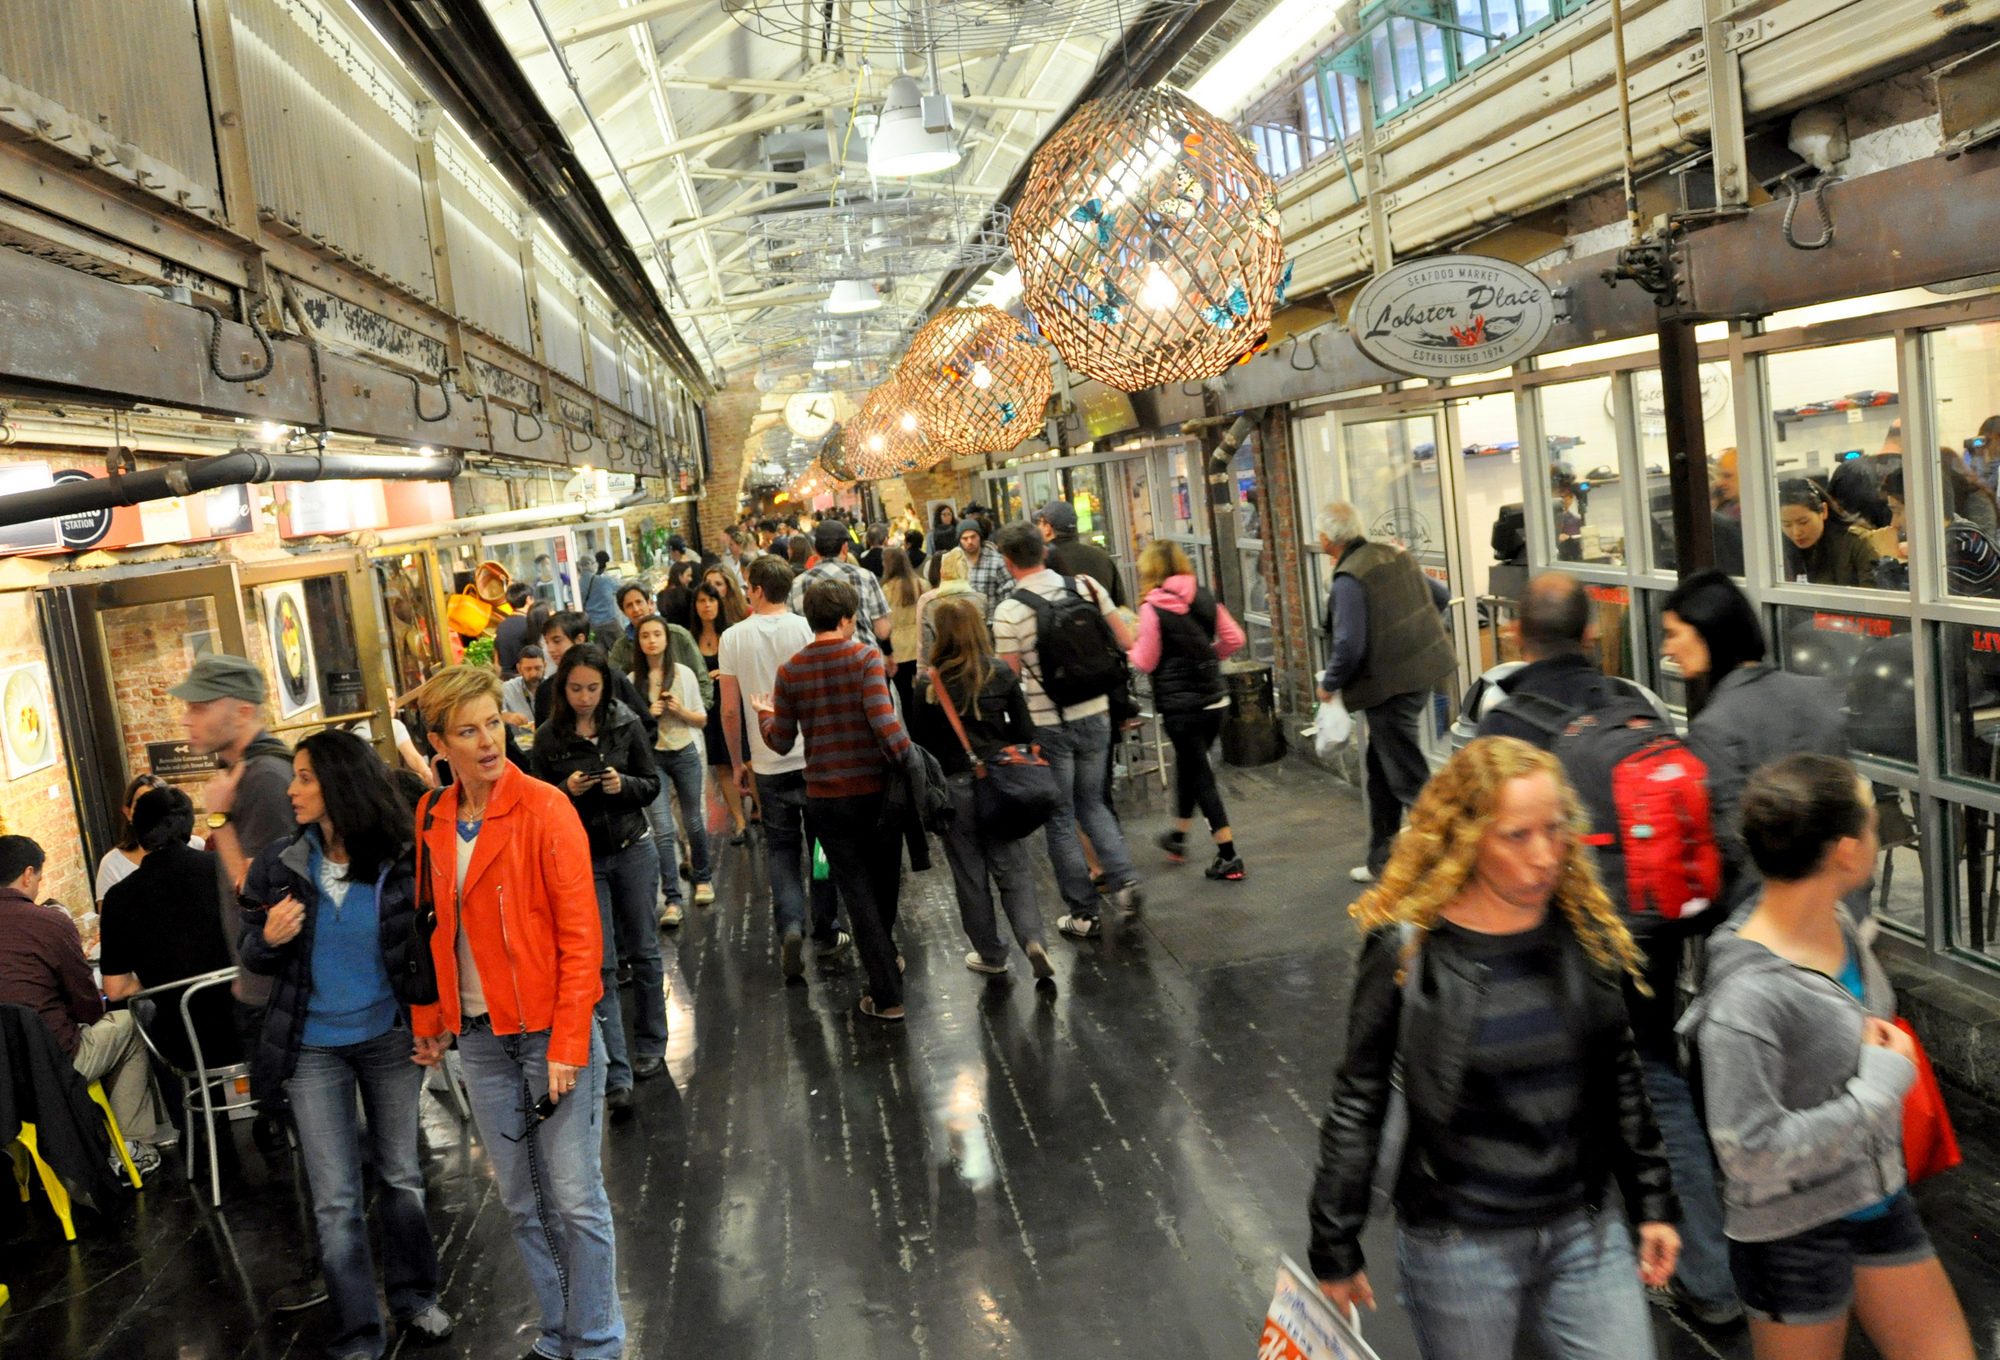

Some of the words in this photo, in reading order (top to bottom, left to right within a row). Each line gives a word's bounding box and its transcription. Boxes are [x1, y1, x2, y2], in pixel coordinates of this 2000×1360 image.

[1407, 268, 1453, 287] SEAFOOD
[1459, 268, 1500, 283] MARKET
[1364, 303, 1457, 341] Lobster
[1466, 284, 1541, 319] Place
[1413, 350, 1479, 364] ESTABLISHED
[1483, 346, 1505, 360] 1974
[64, 518, 95, 530] STATION
